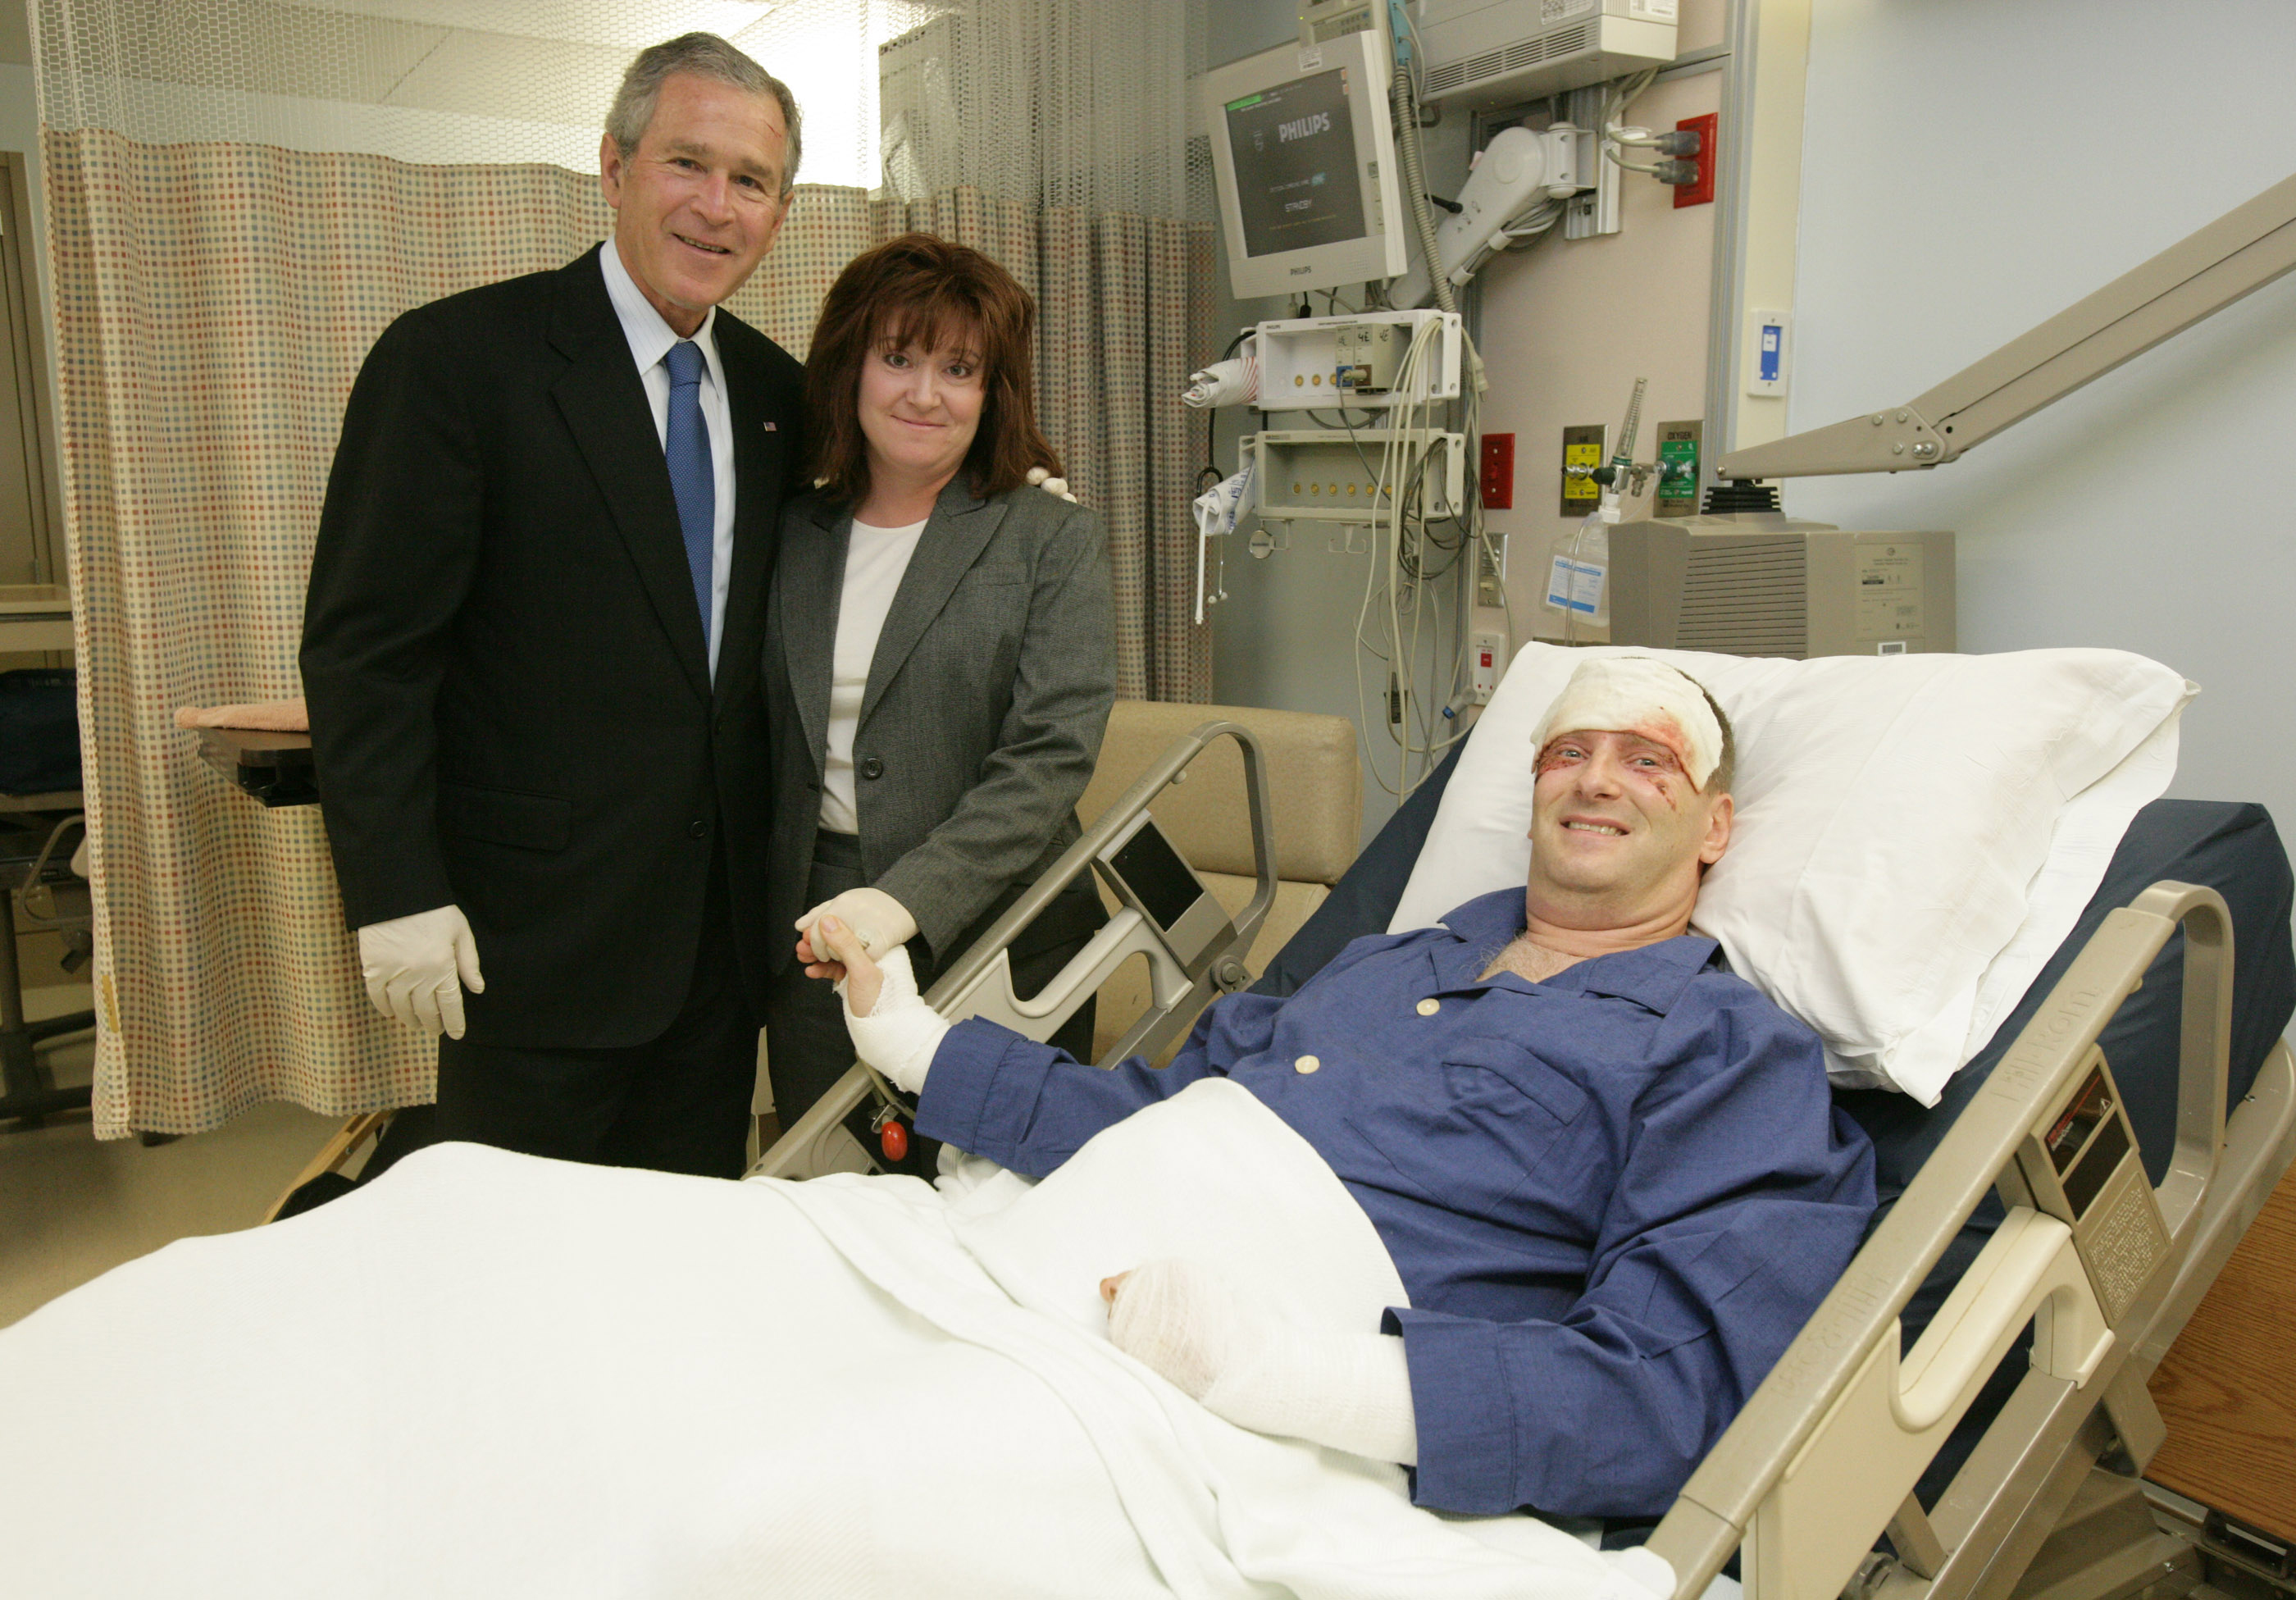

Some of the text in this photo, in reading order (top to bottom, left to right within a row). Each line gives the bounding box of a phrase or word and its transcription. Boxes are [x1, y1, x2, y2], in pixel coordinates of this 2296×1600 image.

[1278, 112, 1330, 143] PHILIPS
[1290, 266, 1311, 276] PHILIPS
[1667, 431, 1692, 440] OXYGEN
